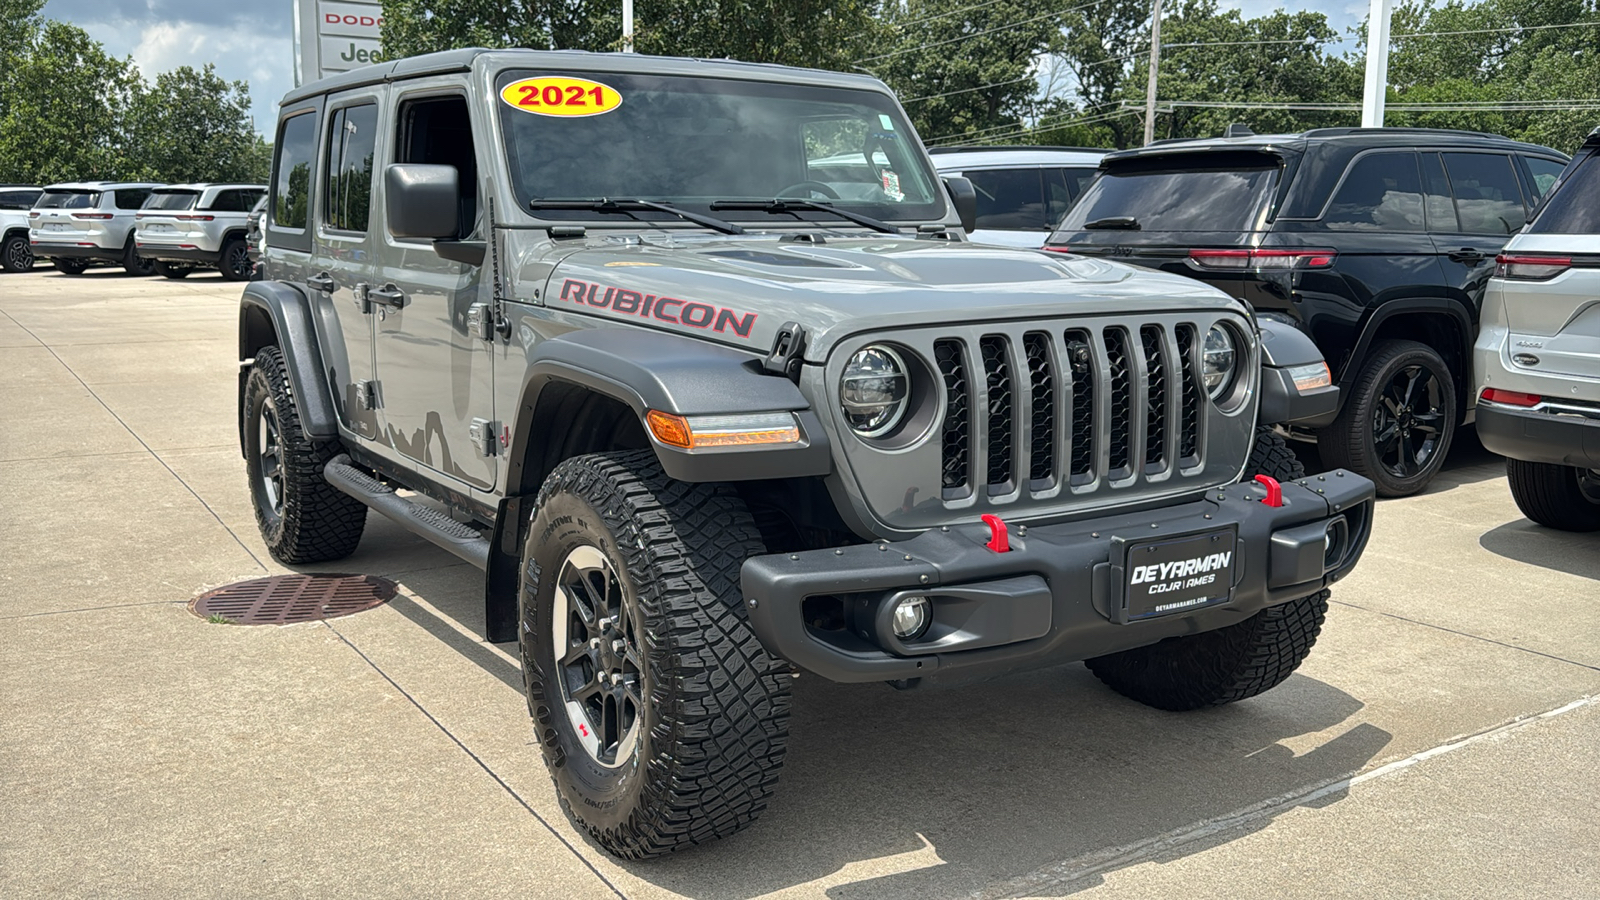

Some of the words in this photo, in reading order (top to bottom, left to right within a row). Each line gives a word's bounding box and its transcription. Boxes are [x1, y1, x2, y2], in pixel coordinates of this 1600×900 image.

[340, 42, 384, 64] Jee
[518, 85, 605, 107] 2021
[559, 279, 758, 338] RUBICON
[1130, 551, 1231, 585] DEYARMAN
[1148, 581, 1182, 594] CDJR
[1186, 573, 1216, 588] AMES
[1155, 596, 1208, 612] DEYARMANAMES.COM
